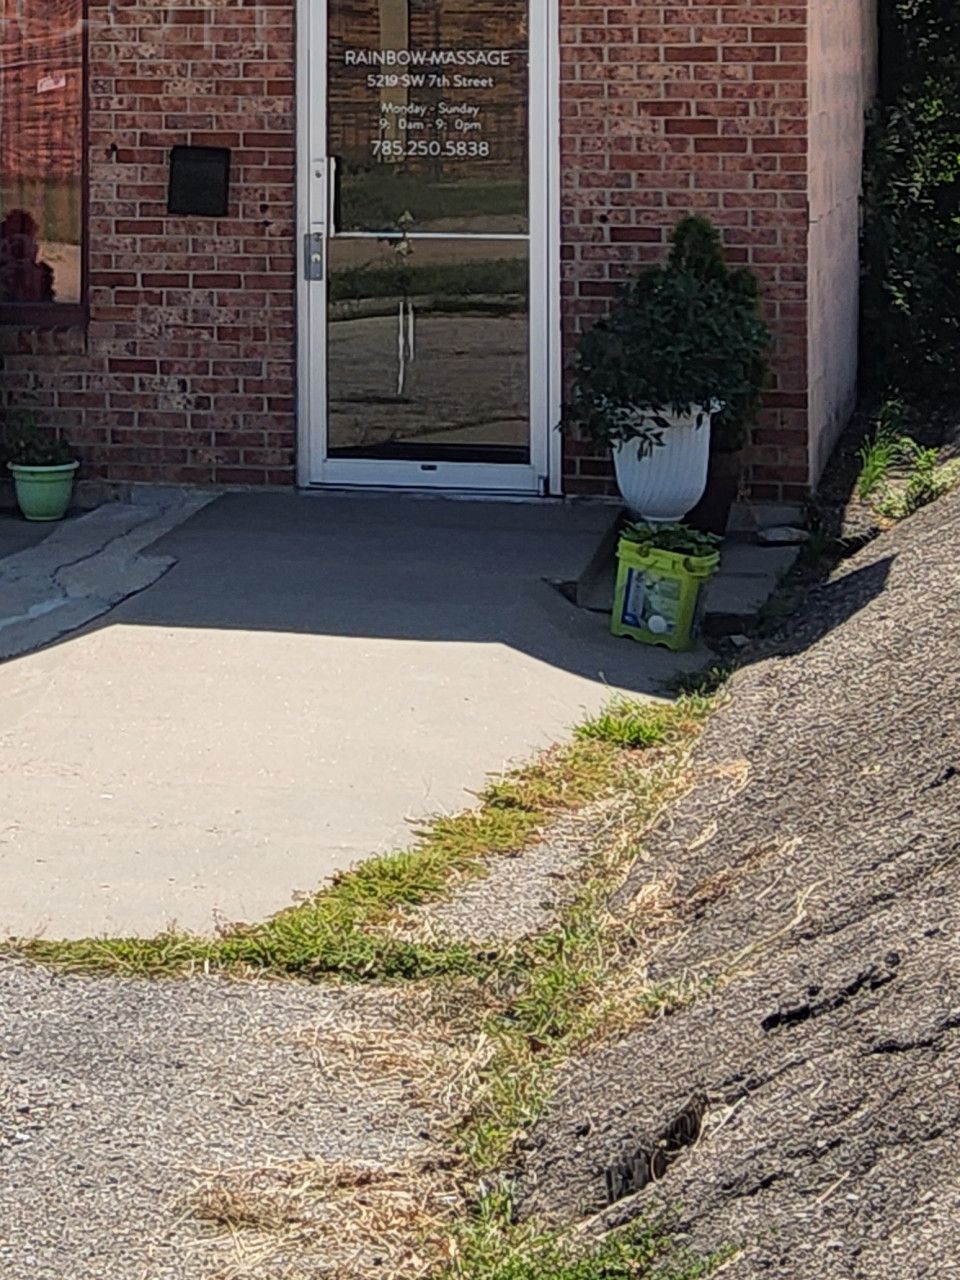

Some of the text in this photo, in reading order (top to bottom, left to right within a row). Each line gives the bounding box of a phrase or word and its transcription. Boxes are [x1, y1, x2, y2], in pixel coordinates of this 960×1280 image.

[344, 50, 511, 66] RAINBOW MASSAGE
[366, 74, 494, 88] 5219 SW 7th Street
[381, 102, 428, 118] Monday
[438, 102, 480, 118] Sunday
[370, 140, 490, 156] 785.250.5838
